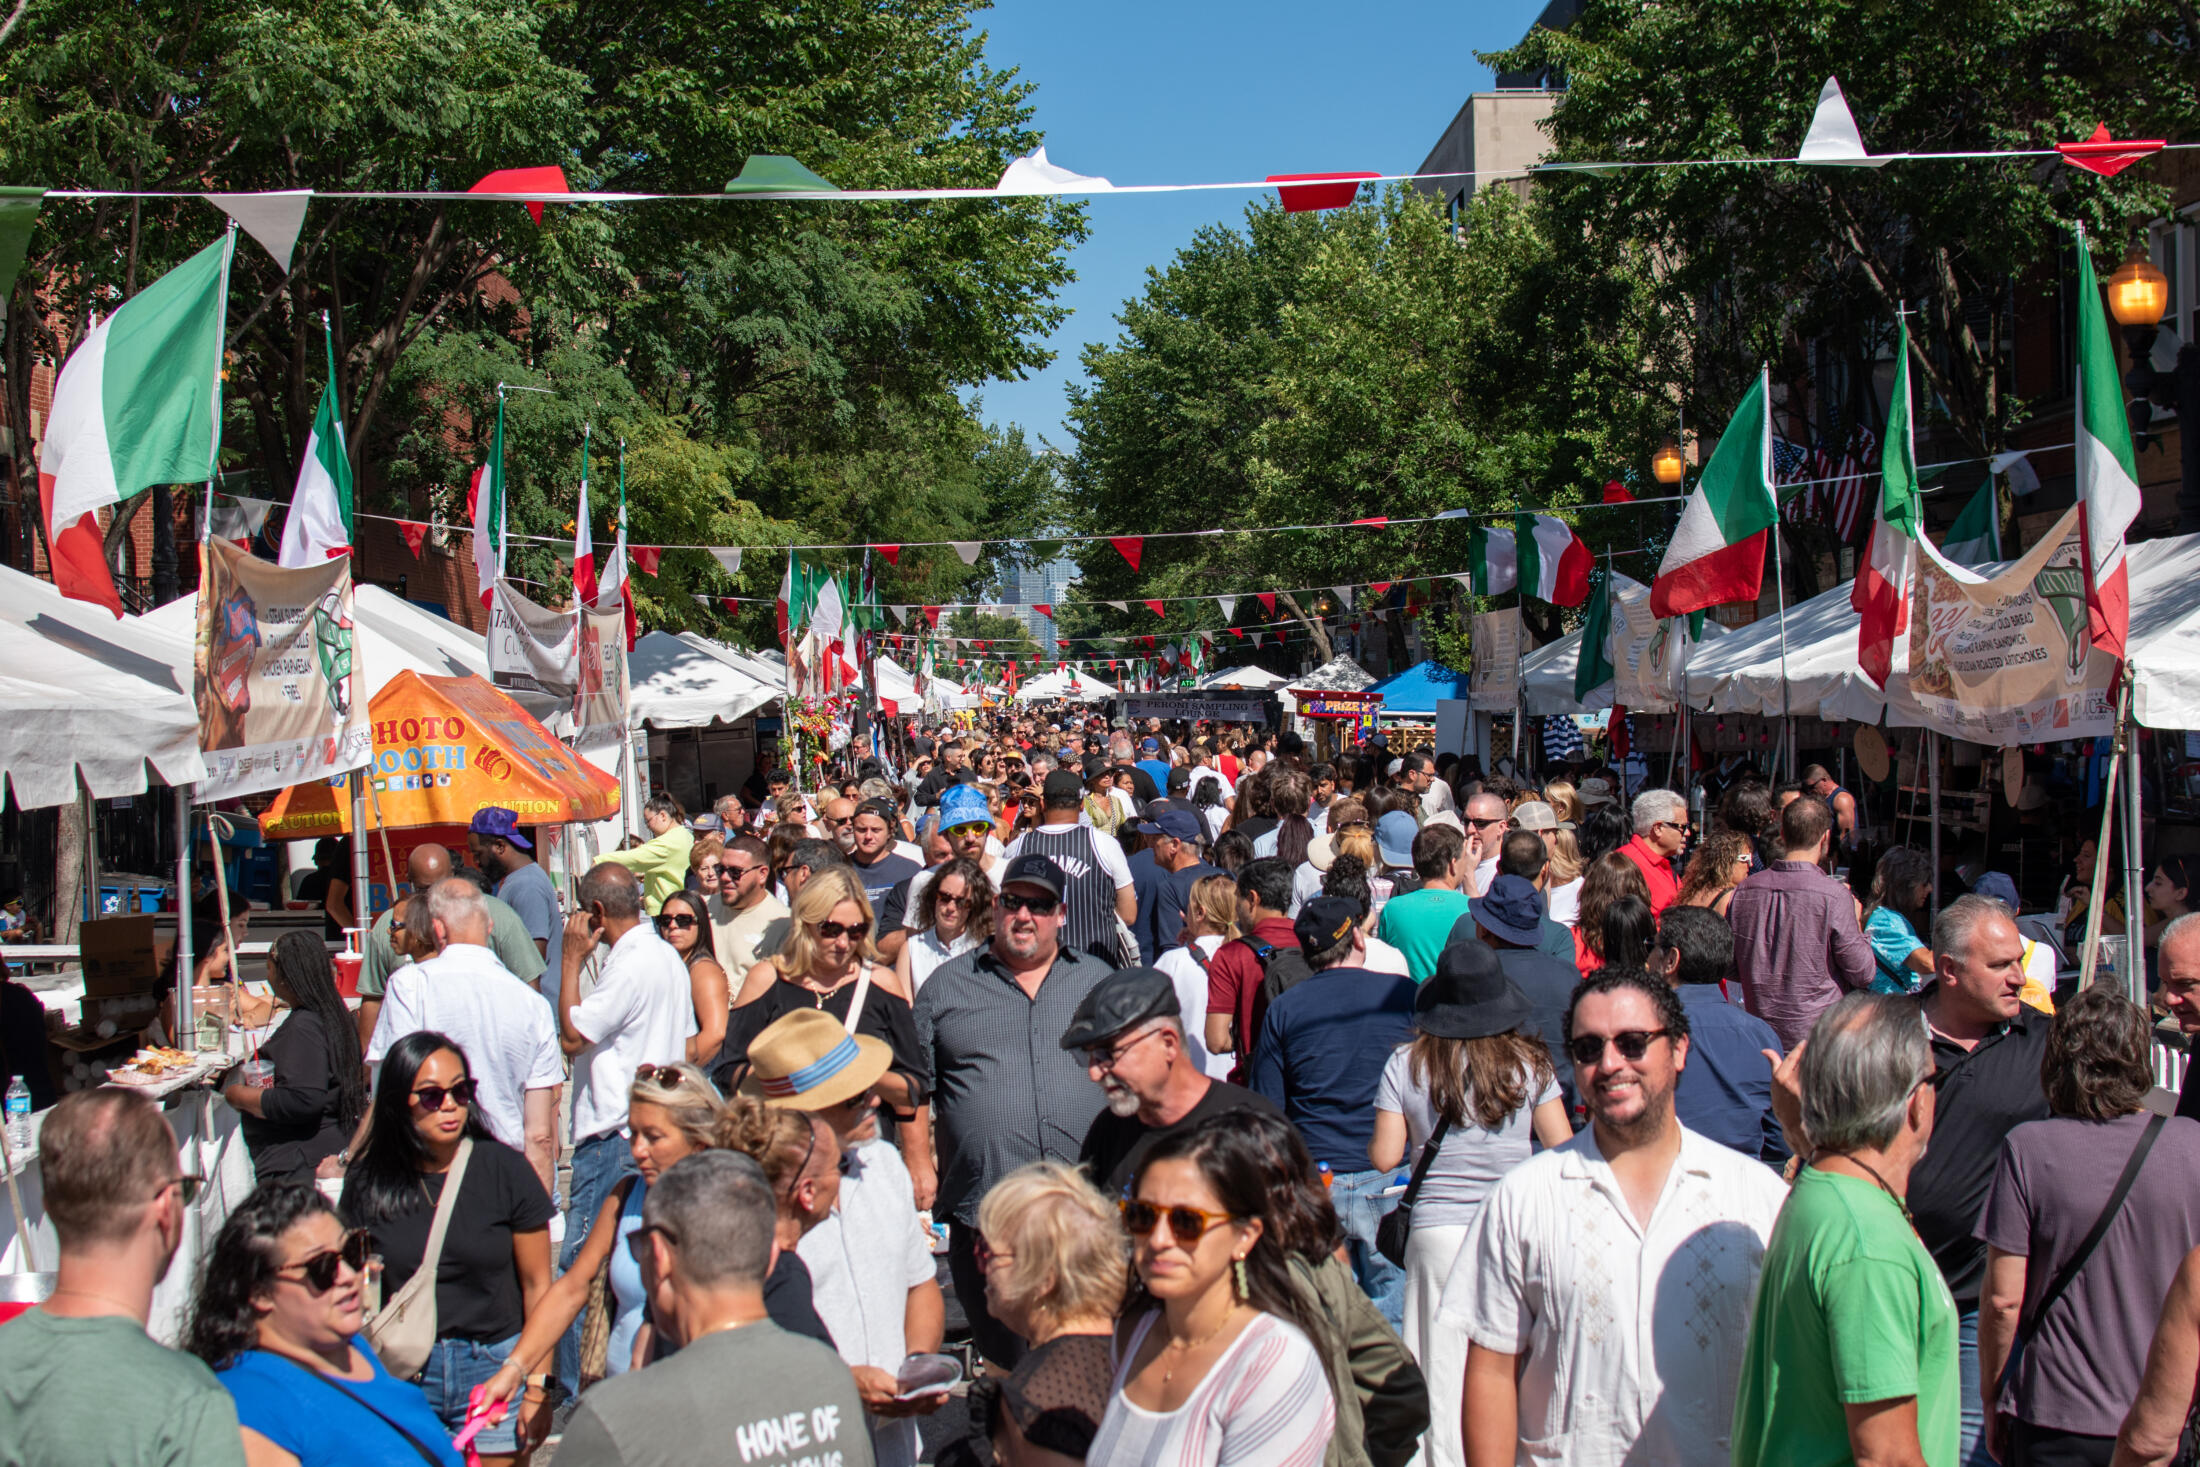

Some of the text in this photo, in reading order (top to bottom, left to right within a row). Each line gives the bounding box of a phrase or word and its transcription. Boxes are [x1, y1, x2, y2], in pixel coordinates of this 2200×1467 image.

[2040, 571, 2078, 593] LITTLE
[2011, 612, 2034, 627] BREAD
[1976, 656, 2004, 670] ROASTED
[2004, 647, 2048, 666] ARTICHOKES
[1180, 679, 1196, 688] ATM
[1147, 701, 1249, 712] PERONI SAMPLING
[1175, 709, 1221, 719] LOUNGE
[1325, 700, 1360, 712] PRIZE
[371, 716, 466, 745] HOTO
[265, 810, 346, 832] CAUTION
[735, 1404, 842, 1464] HOME OF
